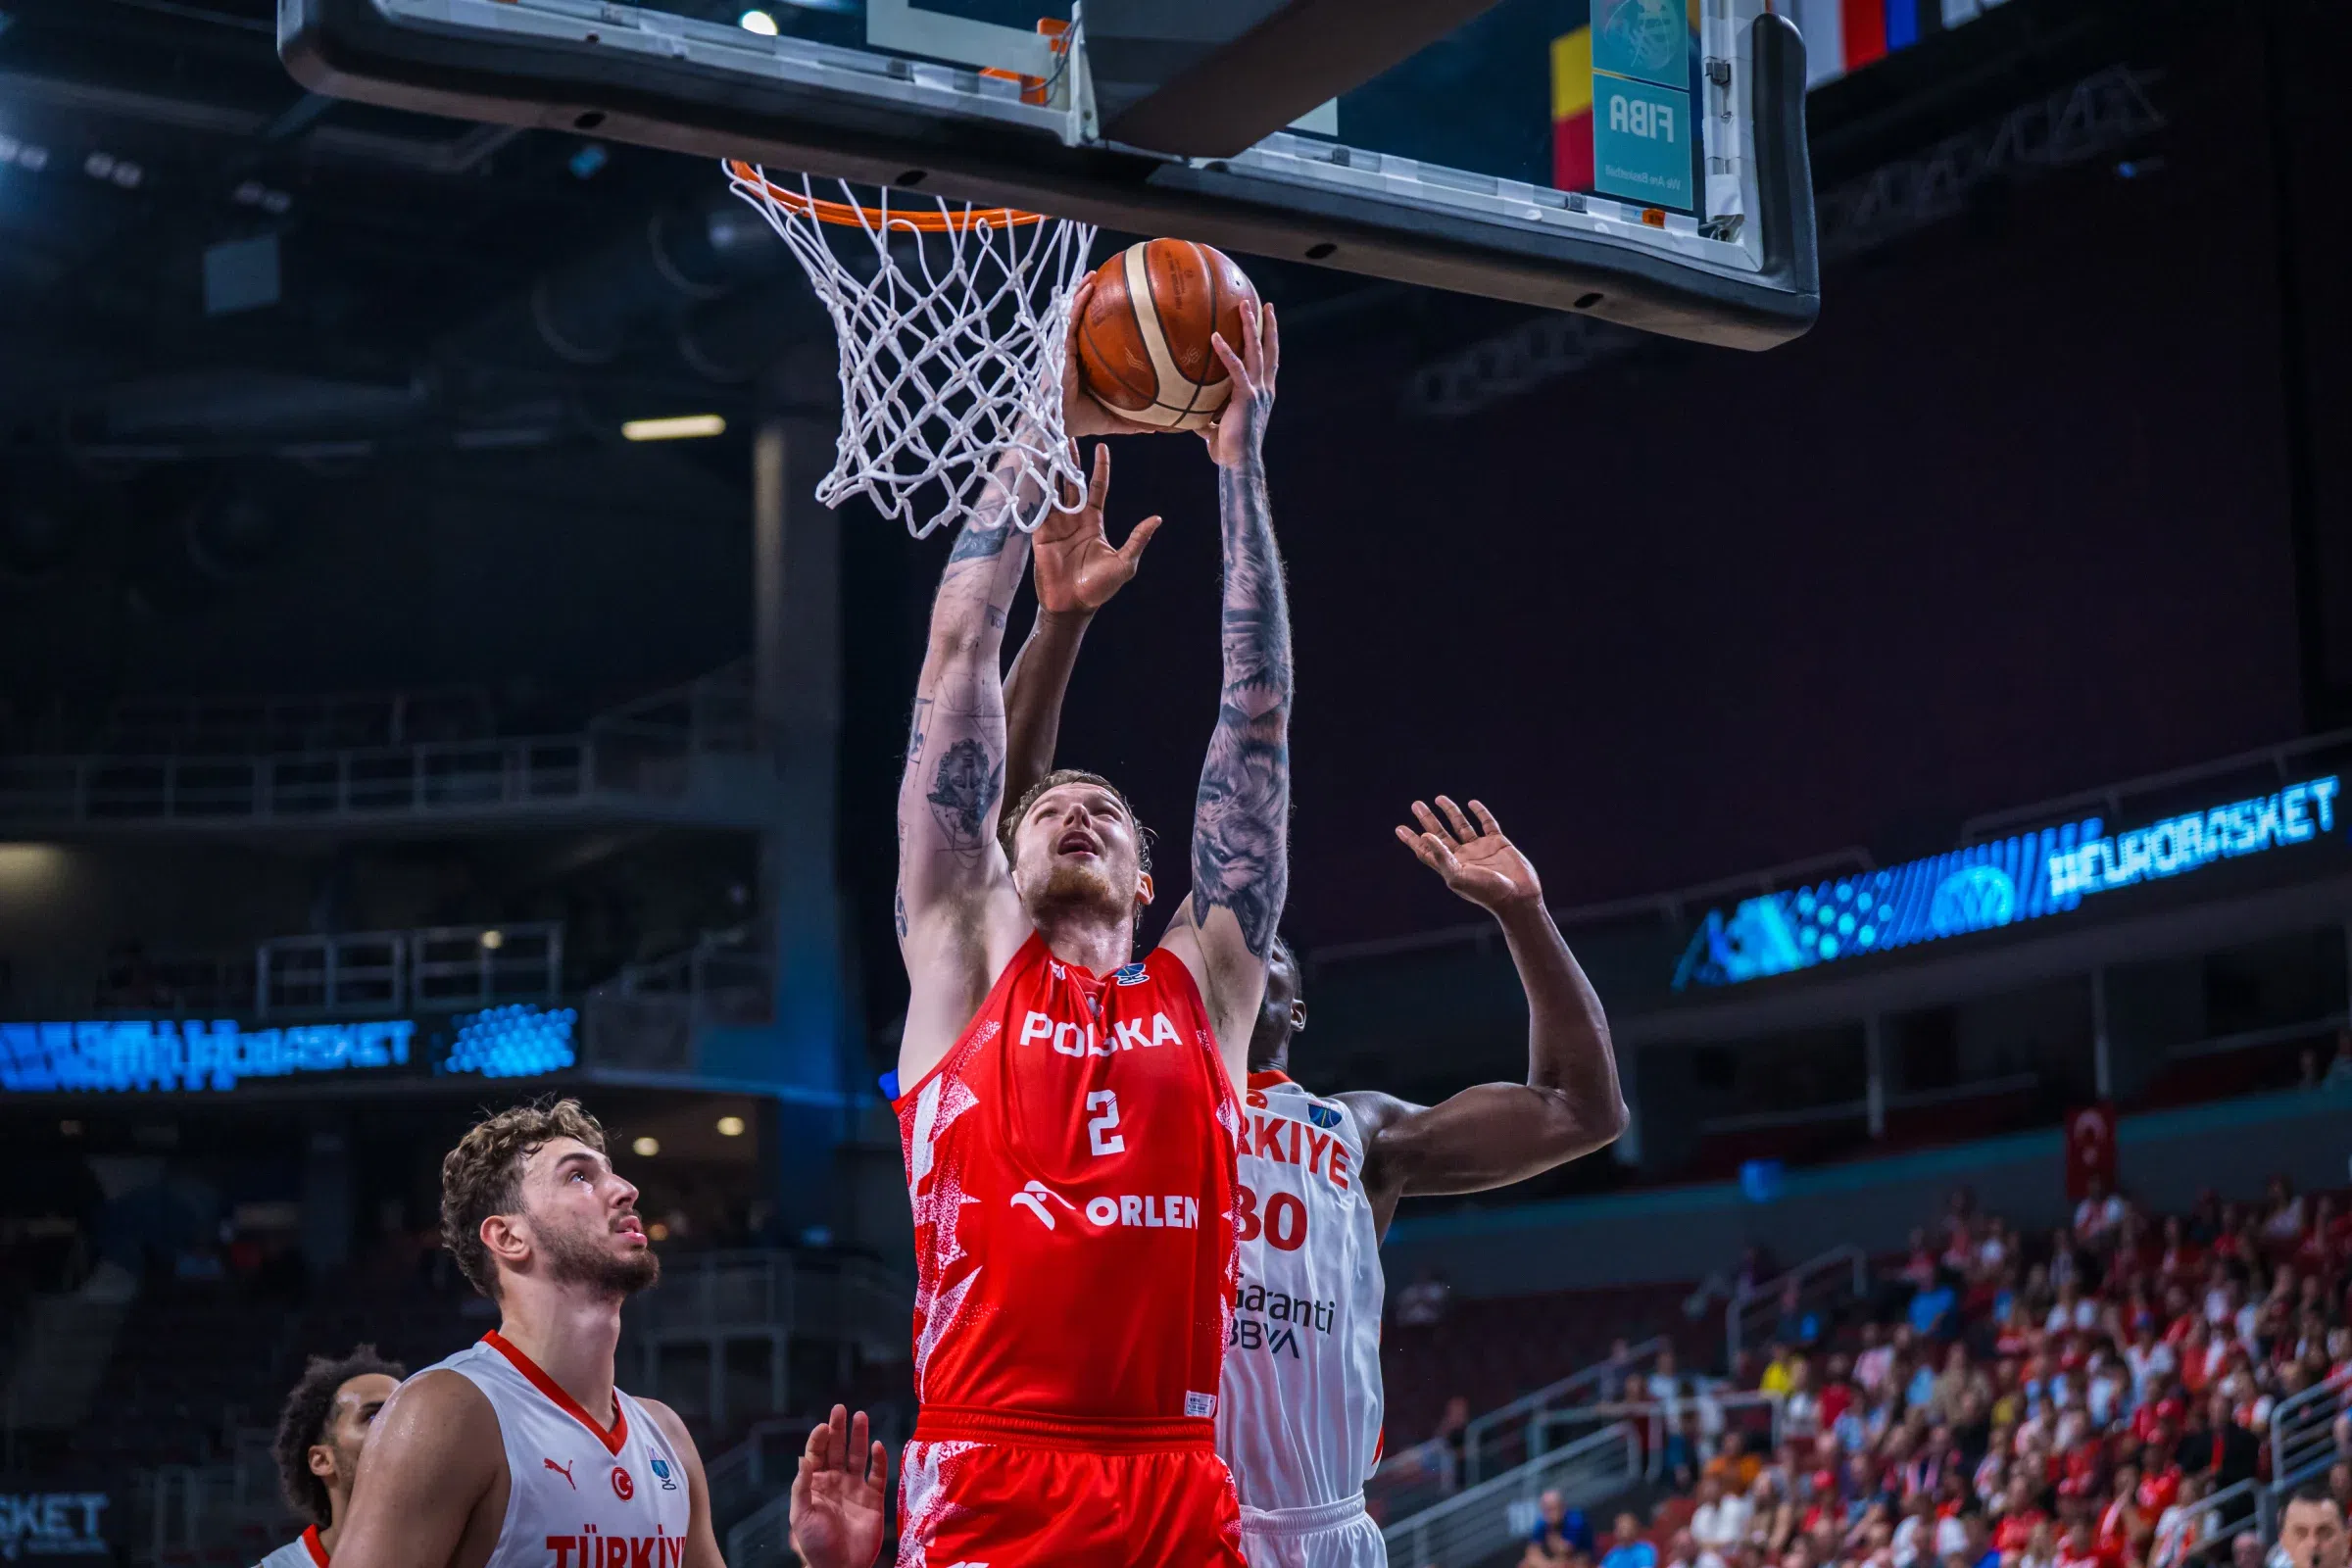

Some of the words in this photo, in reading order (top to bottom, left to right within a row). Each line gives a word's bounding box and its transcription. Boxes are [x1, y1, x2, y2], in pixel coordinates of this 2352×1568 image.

[1019, 1010, 1183, 1058] POLSKA
[1087, 1089, 1125, 1156] 2
[1086, 1195, 1200, 1230] ORLEN
[1237, 1184, 1308, 1251] 30
[546, 1523, 686, 1568] TÜRKİY
